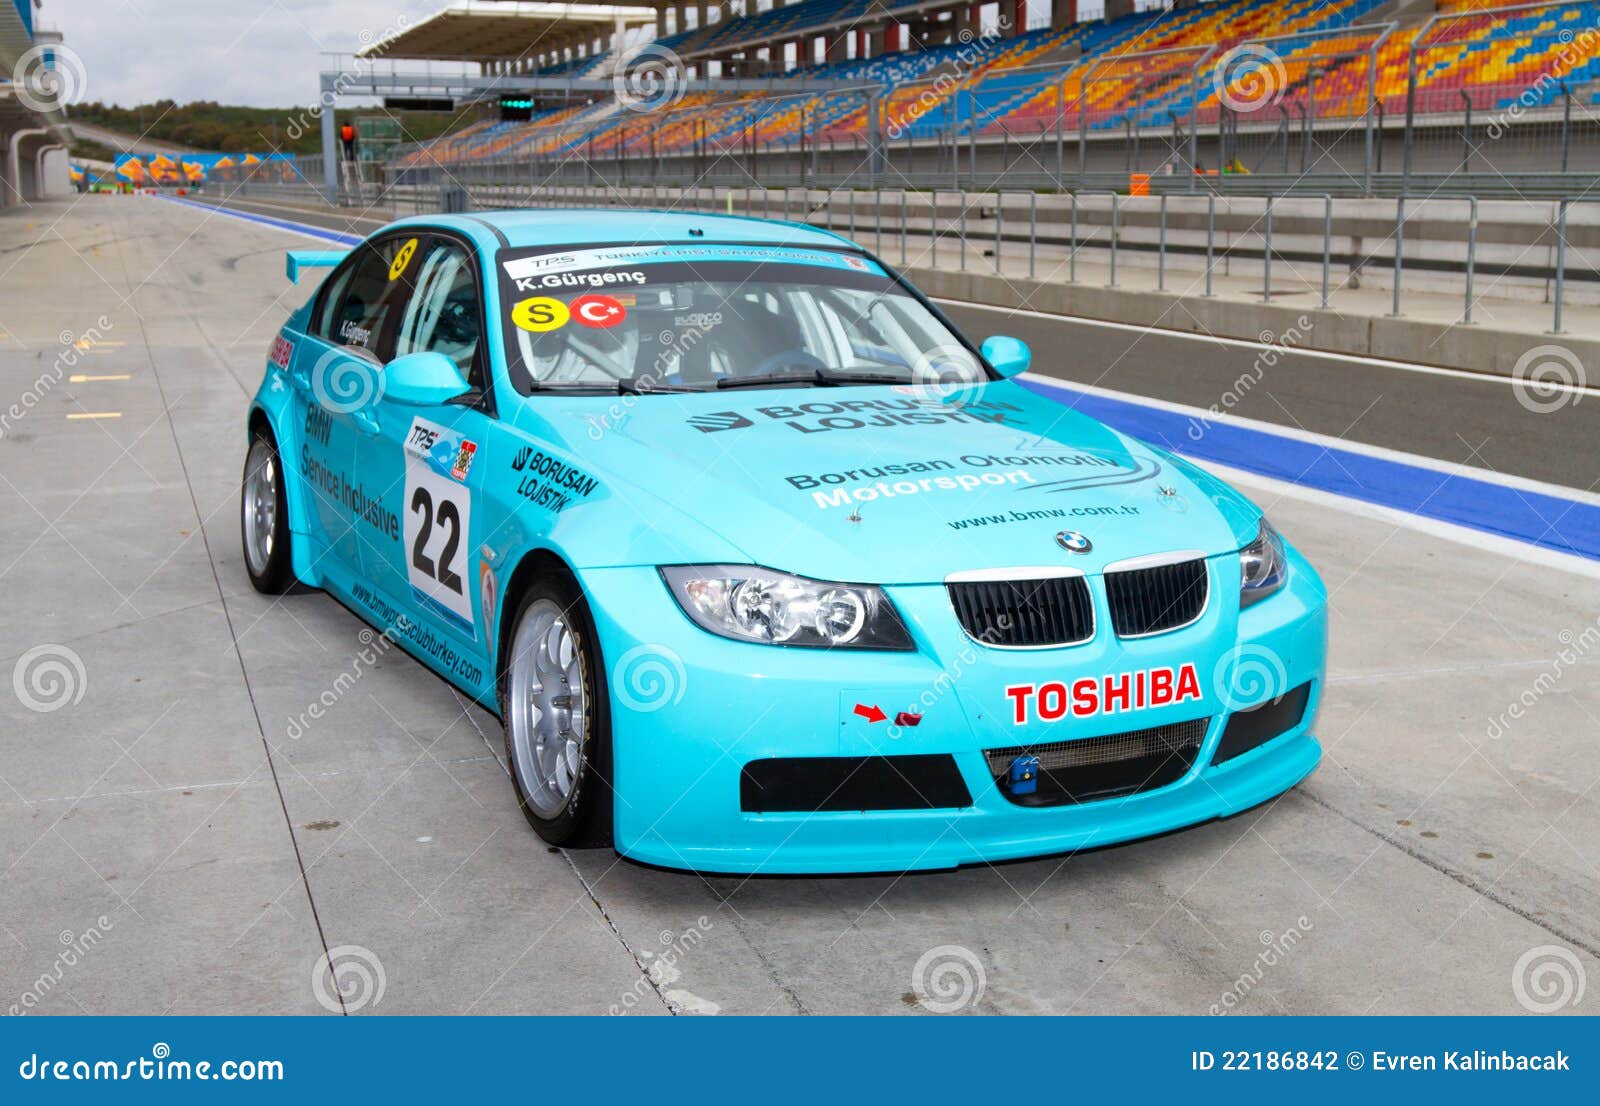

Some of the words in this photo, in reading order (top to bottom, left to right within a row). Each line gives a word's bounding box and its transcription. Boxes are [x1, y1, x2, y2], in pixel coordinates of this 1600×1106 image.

[395, 246, 412, 272] S
[531, 254, 576, 268] TPS
[515, 270, 647, 292] K.Gürgenç
[527, 303, 555, 325] S
[303, 402, 334, 448] BMW
[410, 426, 434, 450] TPS
[529, 451, 599, 497] BORUSAN
[785, 459, 955, 490] Borusan
[960, 455, 1121, 468] Otomotiv
[812, 468, 1037, 510] Motorsport
[301, 445, 340, 501] Service
[340, 471, 399, 541] Inclusive
[948, 504, 1140, 530] www.bmw.com.tr
[411, 486, 463, 596] 22
[1007, 664, 1202, 724] TOSHIBA
